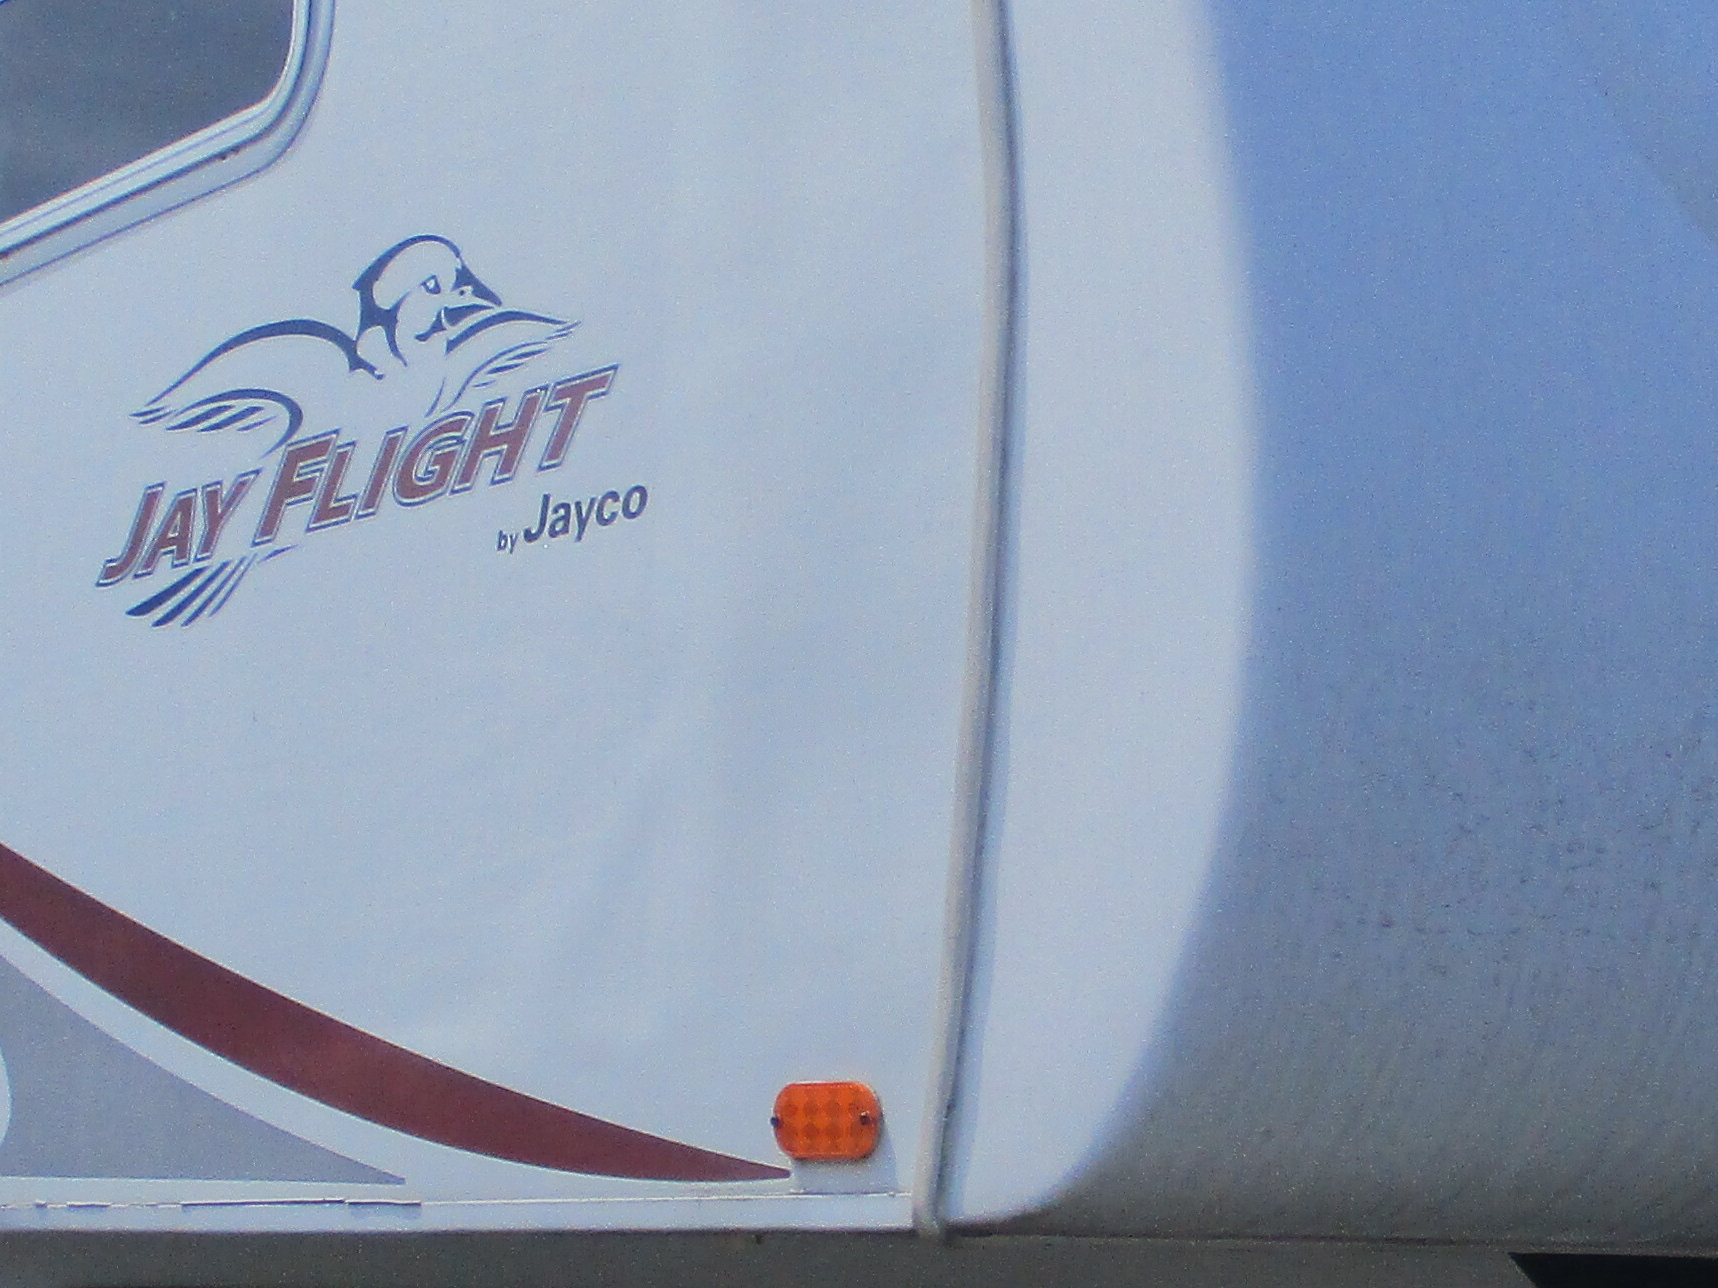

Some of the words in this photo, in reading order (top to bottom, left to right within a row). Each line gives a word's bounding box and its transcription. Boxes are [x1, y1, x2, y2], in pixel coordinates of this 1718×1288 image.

[95, 466, 264, 588] JAY
[249, 363, 621, 549] FLIGHT
[496, 528, 519, 555] by
[522, 483, 649, 546] Jayco
